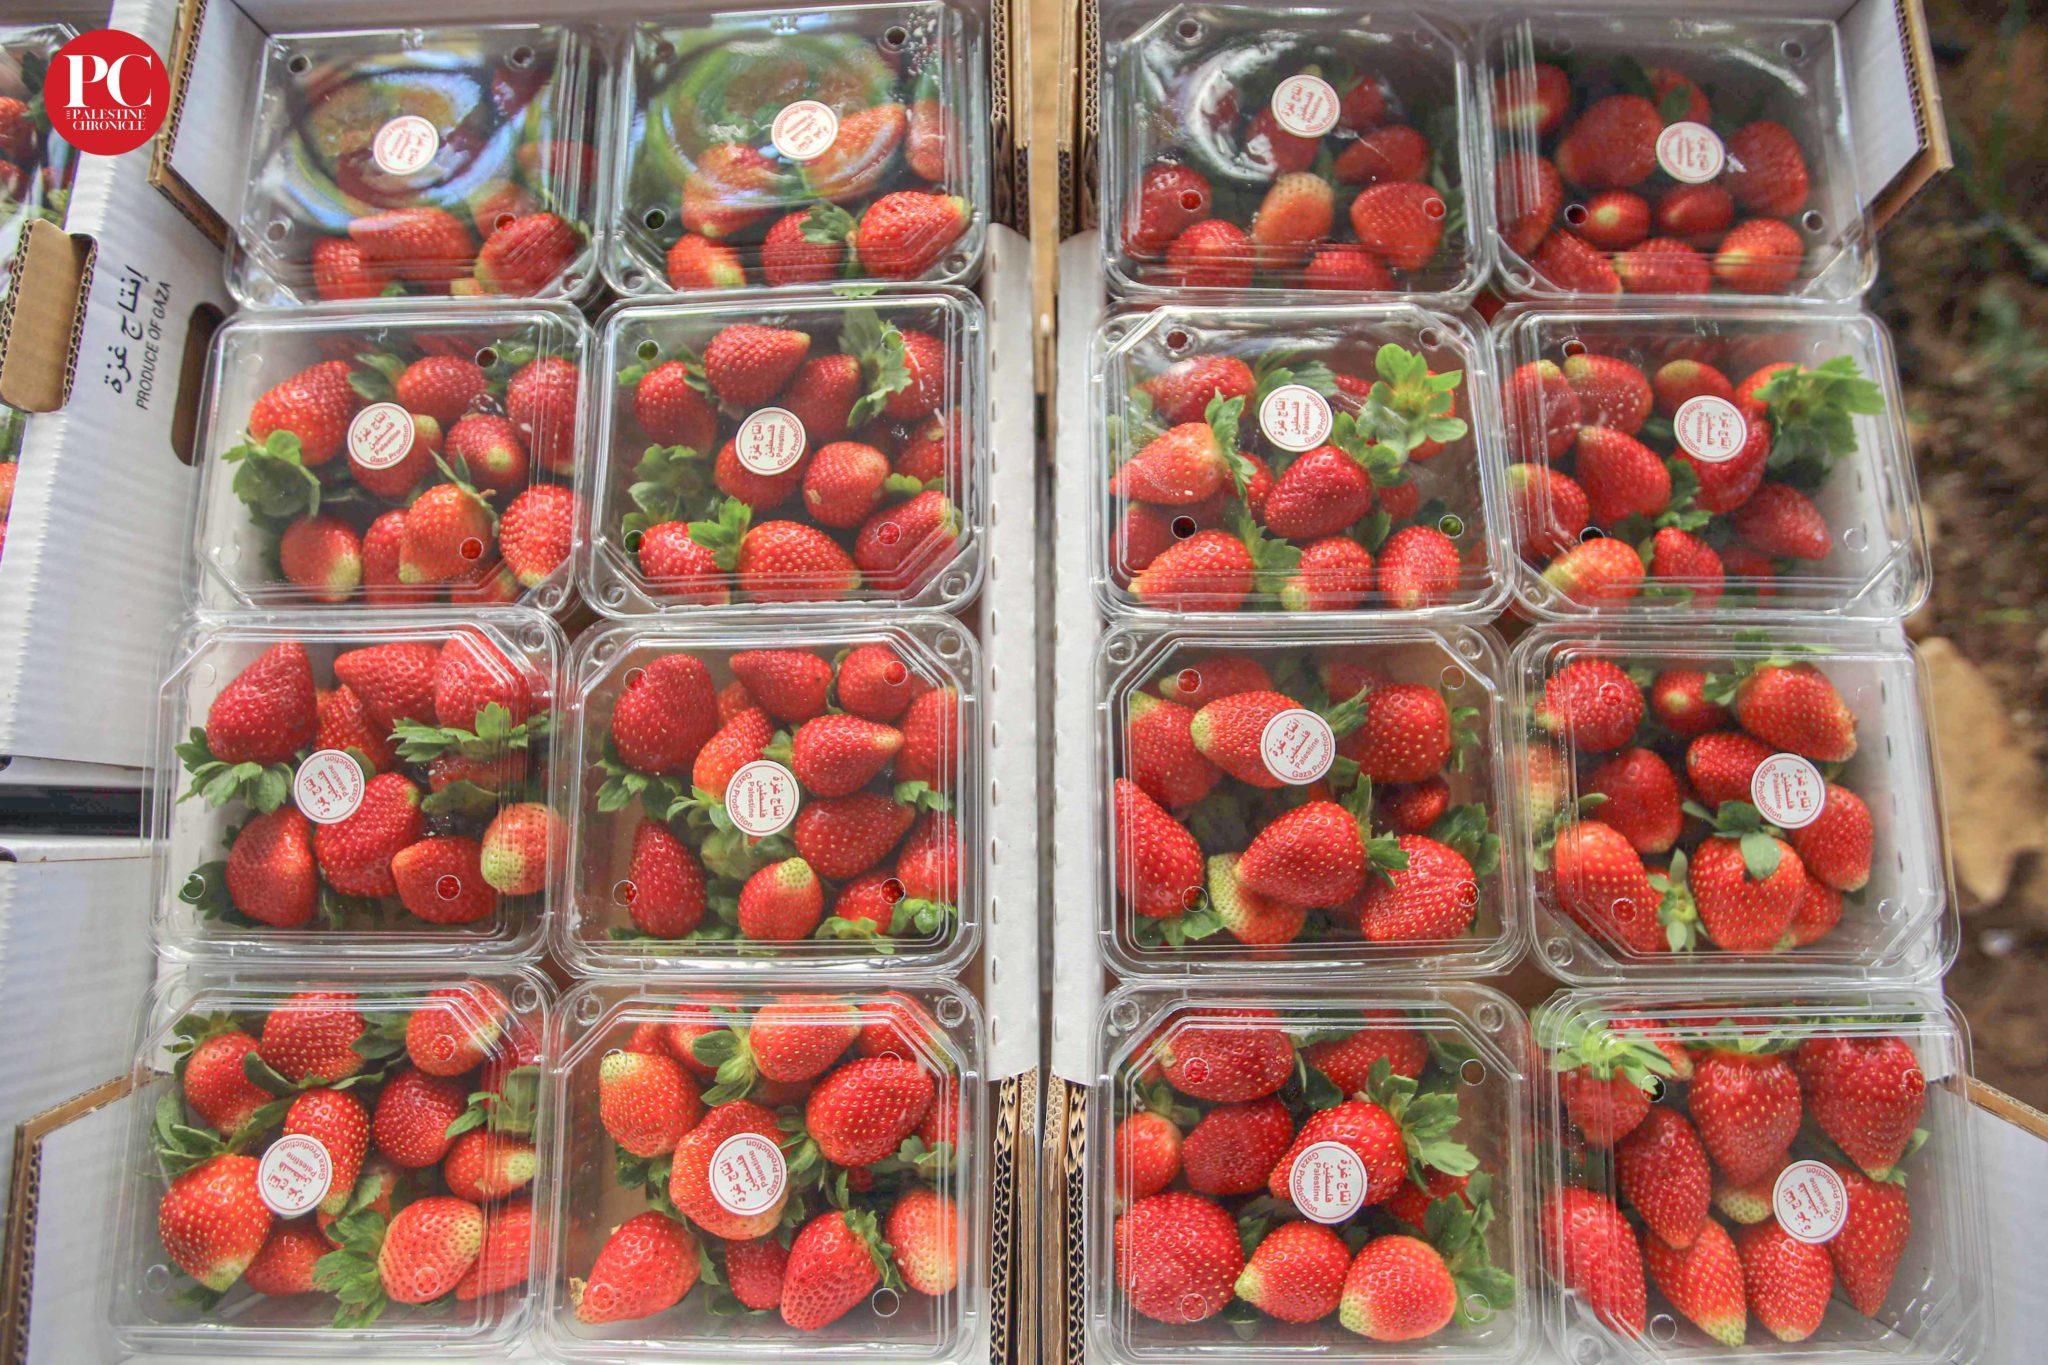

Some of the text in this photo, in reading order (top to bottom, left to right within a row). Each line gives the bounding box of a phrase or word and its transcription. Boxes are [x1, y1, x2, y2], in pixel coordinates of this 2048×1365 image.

[104, 264, 149, 394] إنتاج غزة
[136, 281, 171, 410] PRODUCE OF GAZA
[374, 430, 402, 456] Palestine
[776, 425, 785, 457] Palestine
[1285, 730, 1312, 764] فلسطين
[1294, 739, 1320, 769] Palestine
[1311, 730, 1328, 773] Production
[317, 769, 342, 802] فلسطين
[324, 756, 358, 803] Gaza Production
[328, 764, 350, 796] Palestine
[1758, 764, 1782, 820] Gaza Production
[1772, 774, 1782, 810] Palestine
[1780, 773, 1795, 810] فلسطين
[732, 771, 753, 828] Gaza Production
[757, 780, 767, 818] فلسطين
[279, 1141, 321, 1158] Production
[287, 1151, 318, 1177] Palestine
[746, 1141, 779, 1196] Gaza Production
[749, 1149, 769, 1188] Palestine
[279, 1161, 312, 1187] فلسطين
[736, 1154, 760, 1192] فلسطين
[1297, 1152, 1318, 1213] Gaza Production
[1323, 1163, 1333, 1203] فلسطين
[1798, 1182, 1823, 1219] فلسطين
[1805, 1168, 1840, 1223] Gaza Production
[1809, 1177, 1831, 1215] Palestine
